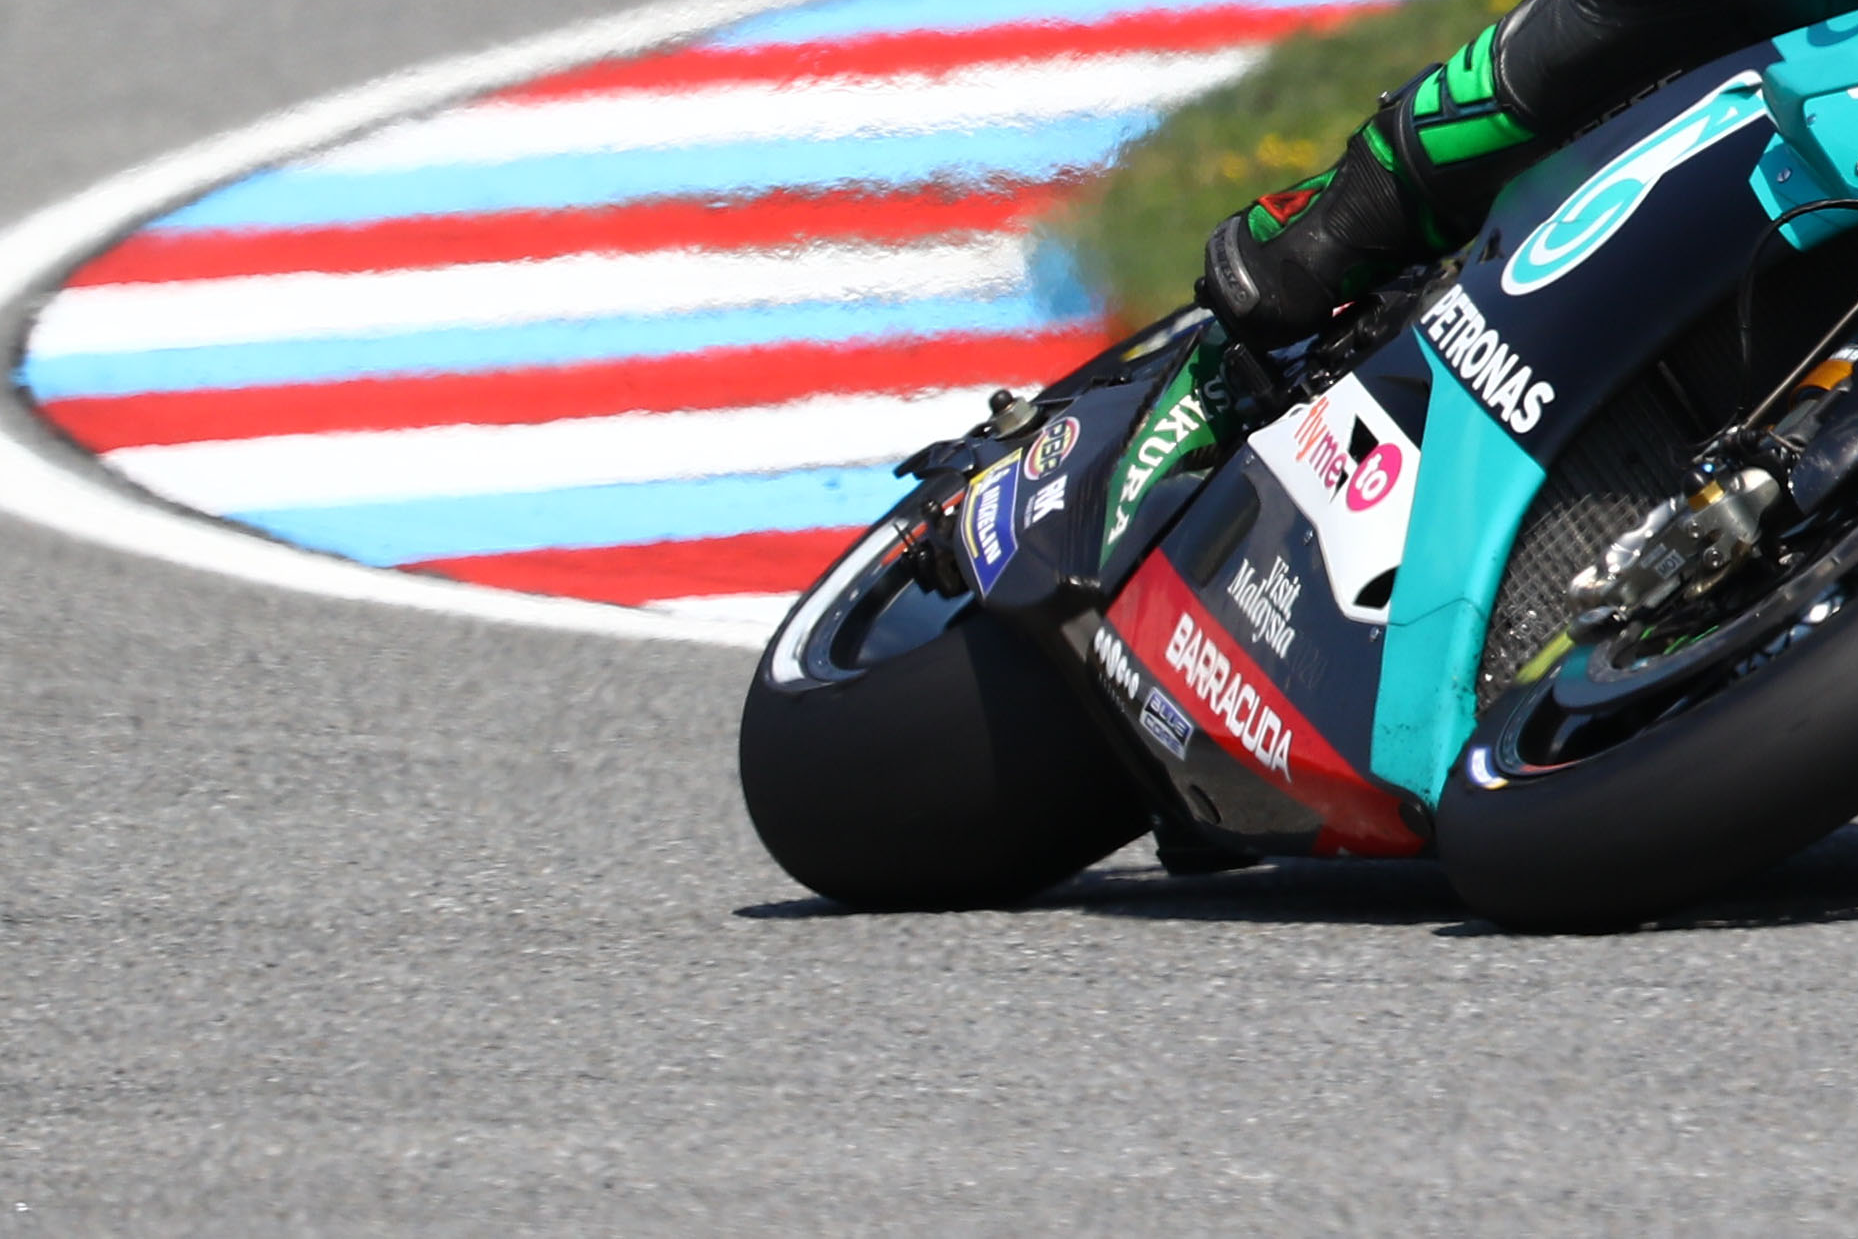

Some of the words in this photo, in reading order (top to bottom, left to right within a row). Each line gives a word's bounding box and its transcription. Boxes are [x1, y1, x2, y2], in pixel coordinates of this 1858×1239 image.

[1420, 283, 1555, 434] PETRONAS
[1032, 475, 1068, 523] RK
[1227, 558, 1295, 658] Malaysia
[1264, 555, 1301, 621] Visit
[1165, 612, 1292, 784] BARRACUDA
